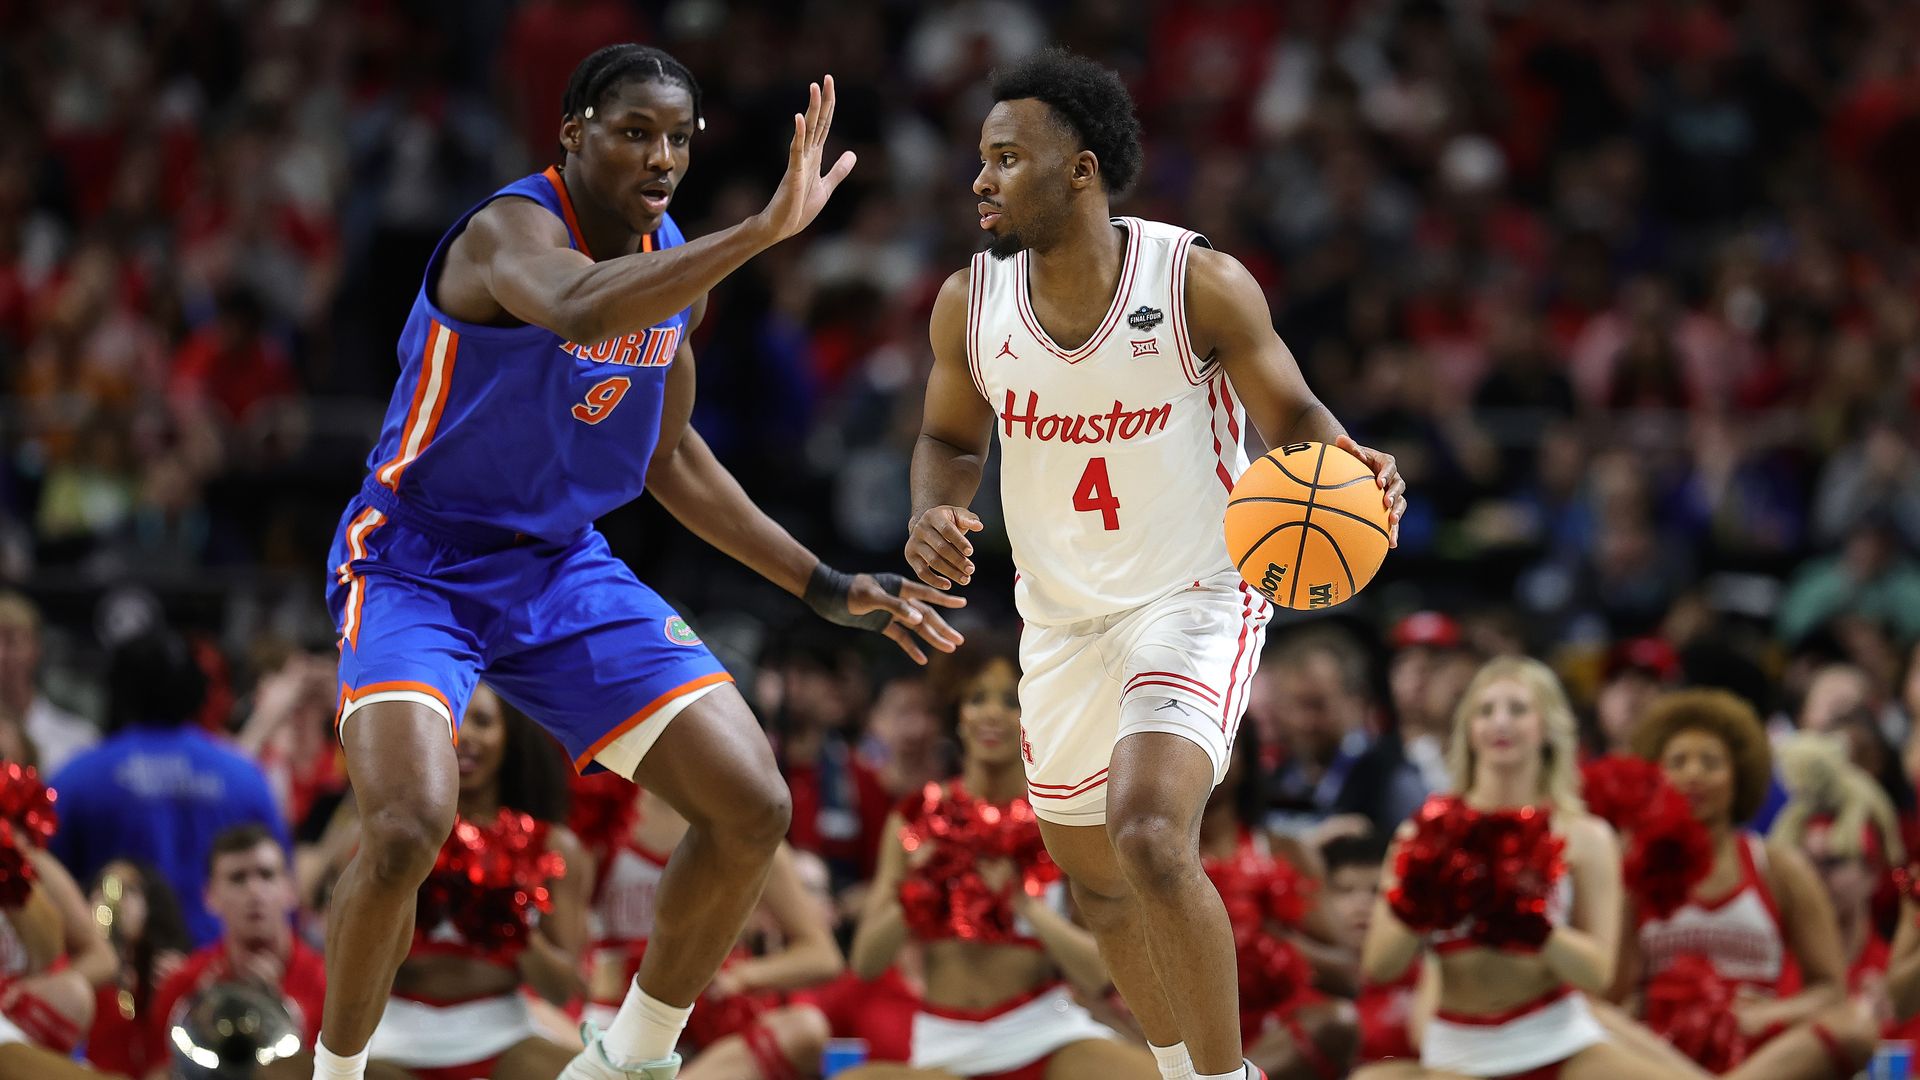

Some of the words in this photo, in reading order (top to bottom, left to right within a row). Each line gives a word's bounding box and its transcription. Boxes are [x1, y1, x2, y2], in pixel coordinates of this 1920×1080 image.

[1130, 315, 1146, 324] FINAL
[1146, 312, 1161, 320] FOUR
[559, 324, 683, 367] ORID
[571, 376, 632, 425] 9
[1000, 388, 1172, 444] Houston
[1072, 457, 1121, 531] 4
